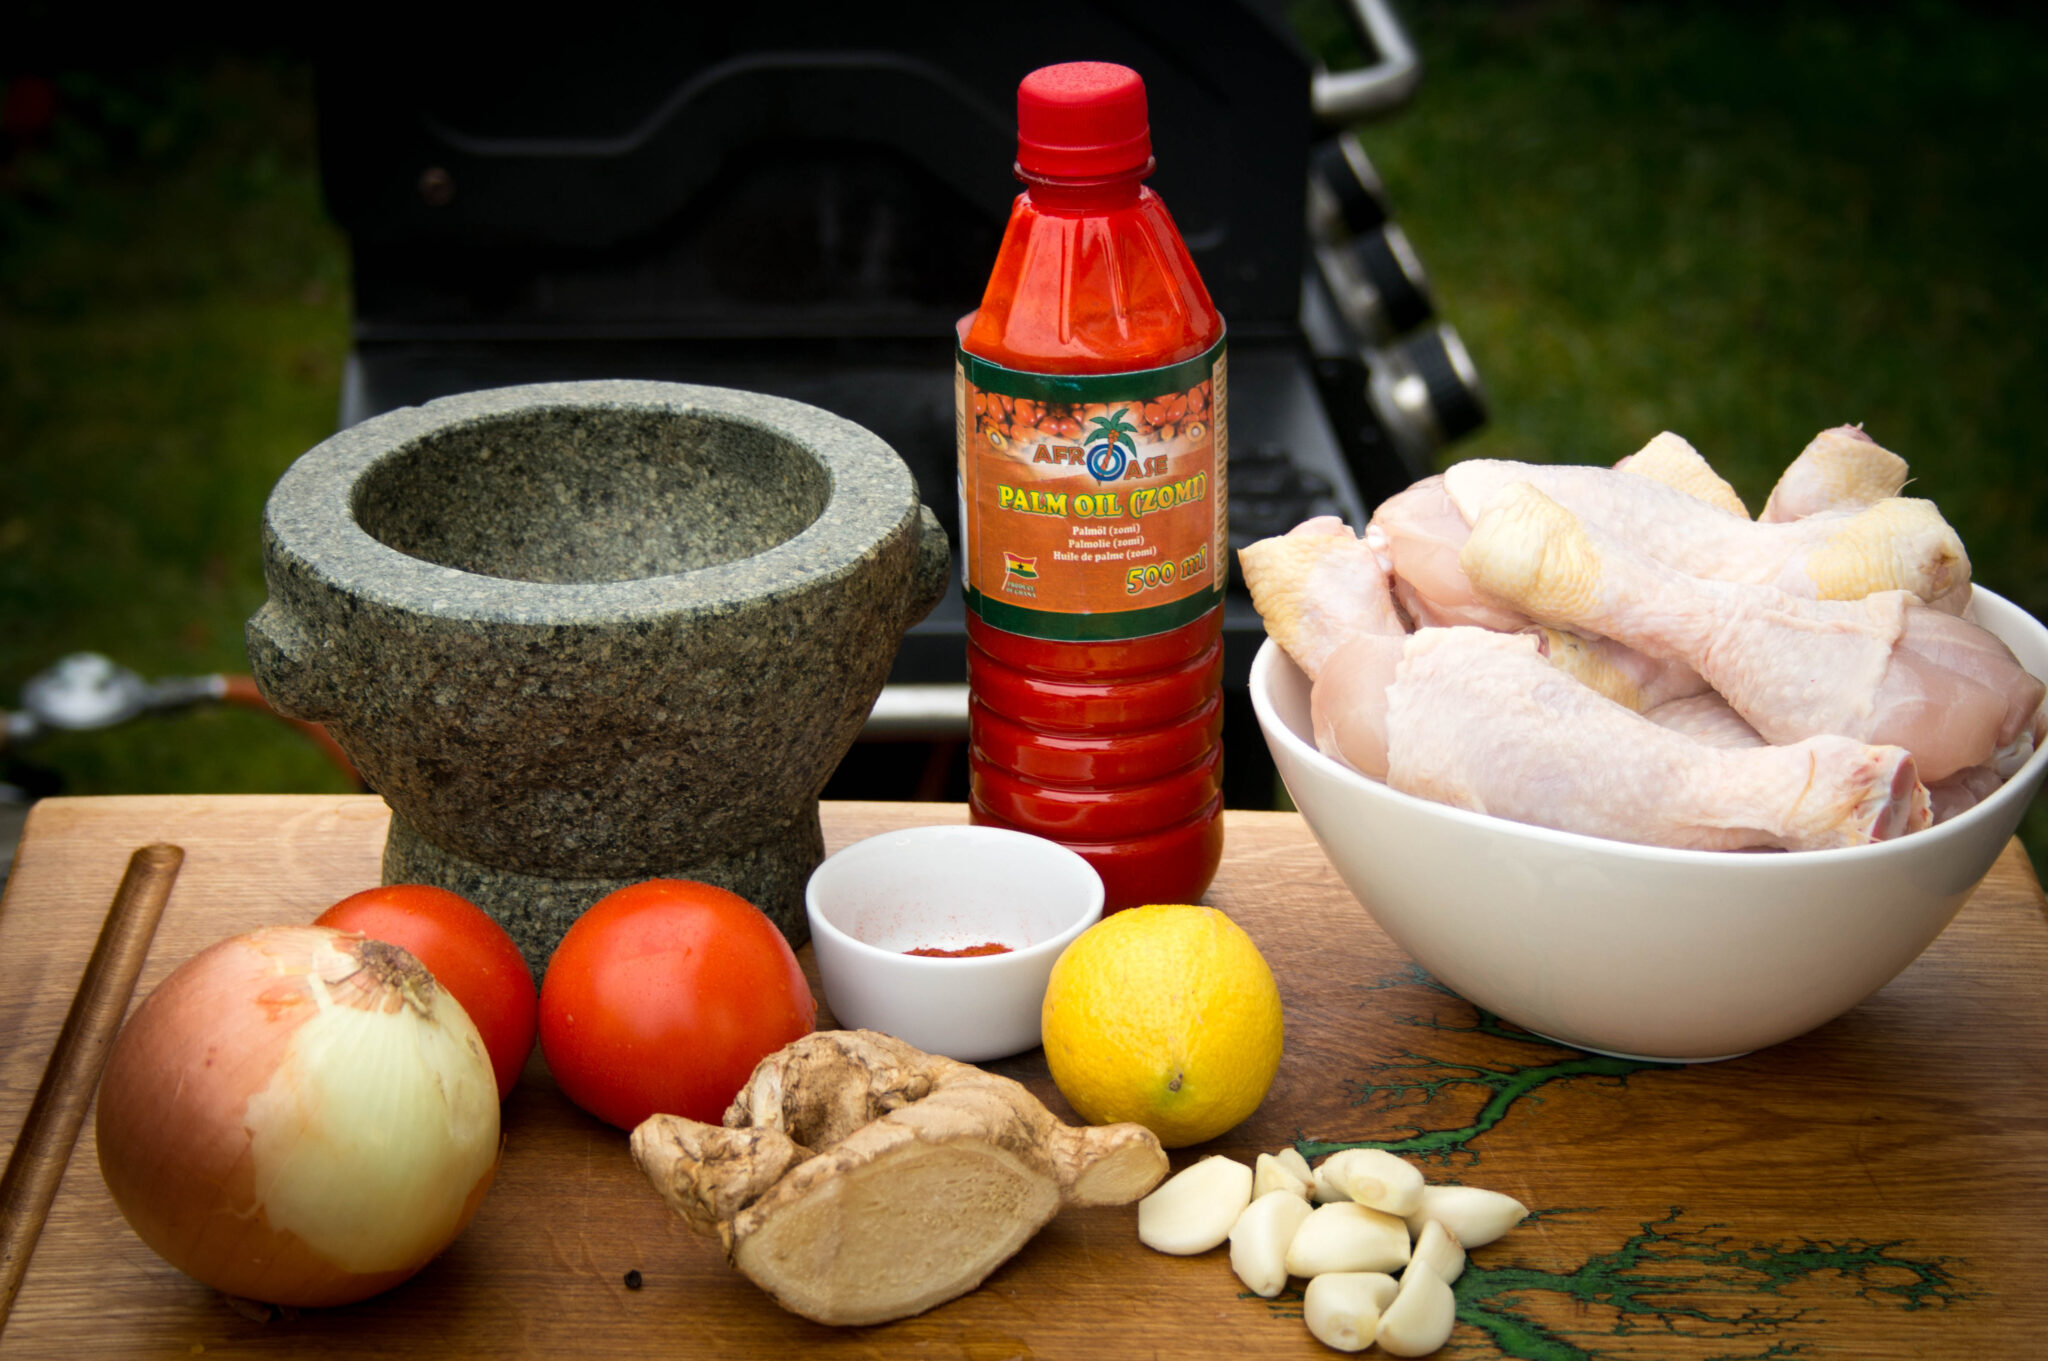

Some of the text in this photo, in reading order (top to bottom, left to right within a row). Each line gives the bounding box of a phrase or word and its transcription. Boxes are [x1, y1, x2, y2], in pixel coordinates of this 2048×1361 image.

[998, 472, 1207, 519] PALM OIL (ZOMI)
[1072, 523, 1141, 537] Palmöl (zomi)
[1068, 536, 1145, 549] Palmolie (zomi)
[1053, 546, 1157, 563] Huile de palme (zomi)
[1126, 543, 1207, 595] 500 ml
